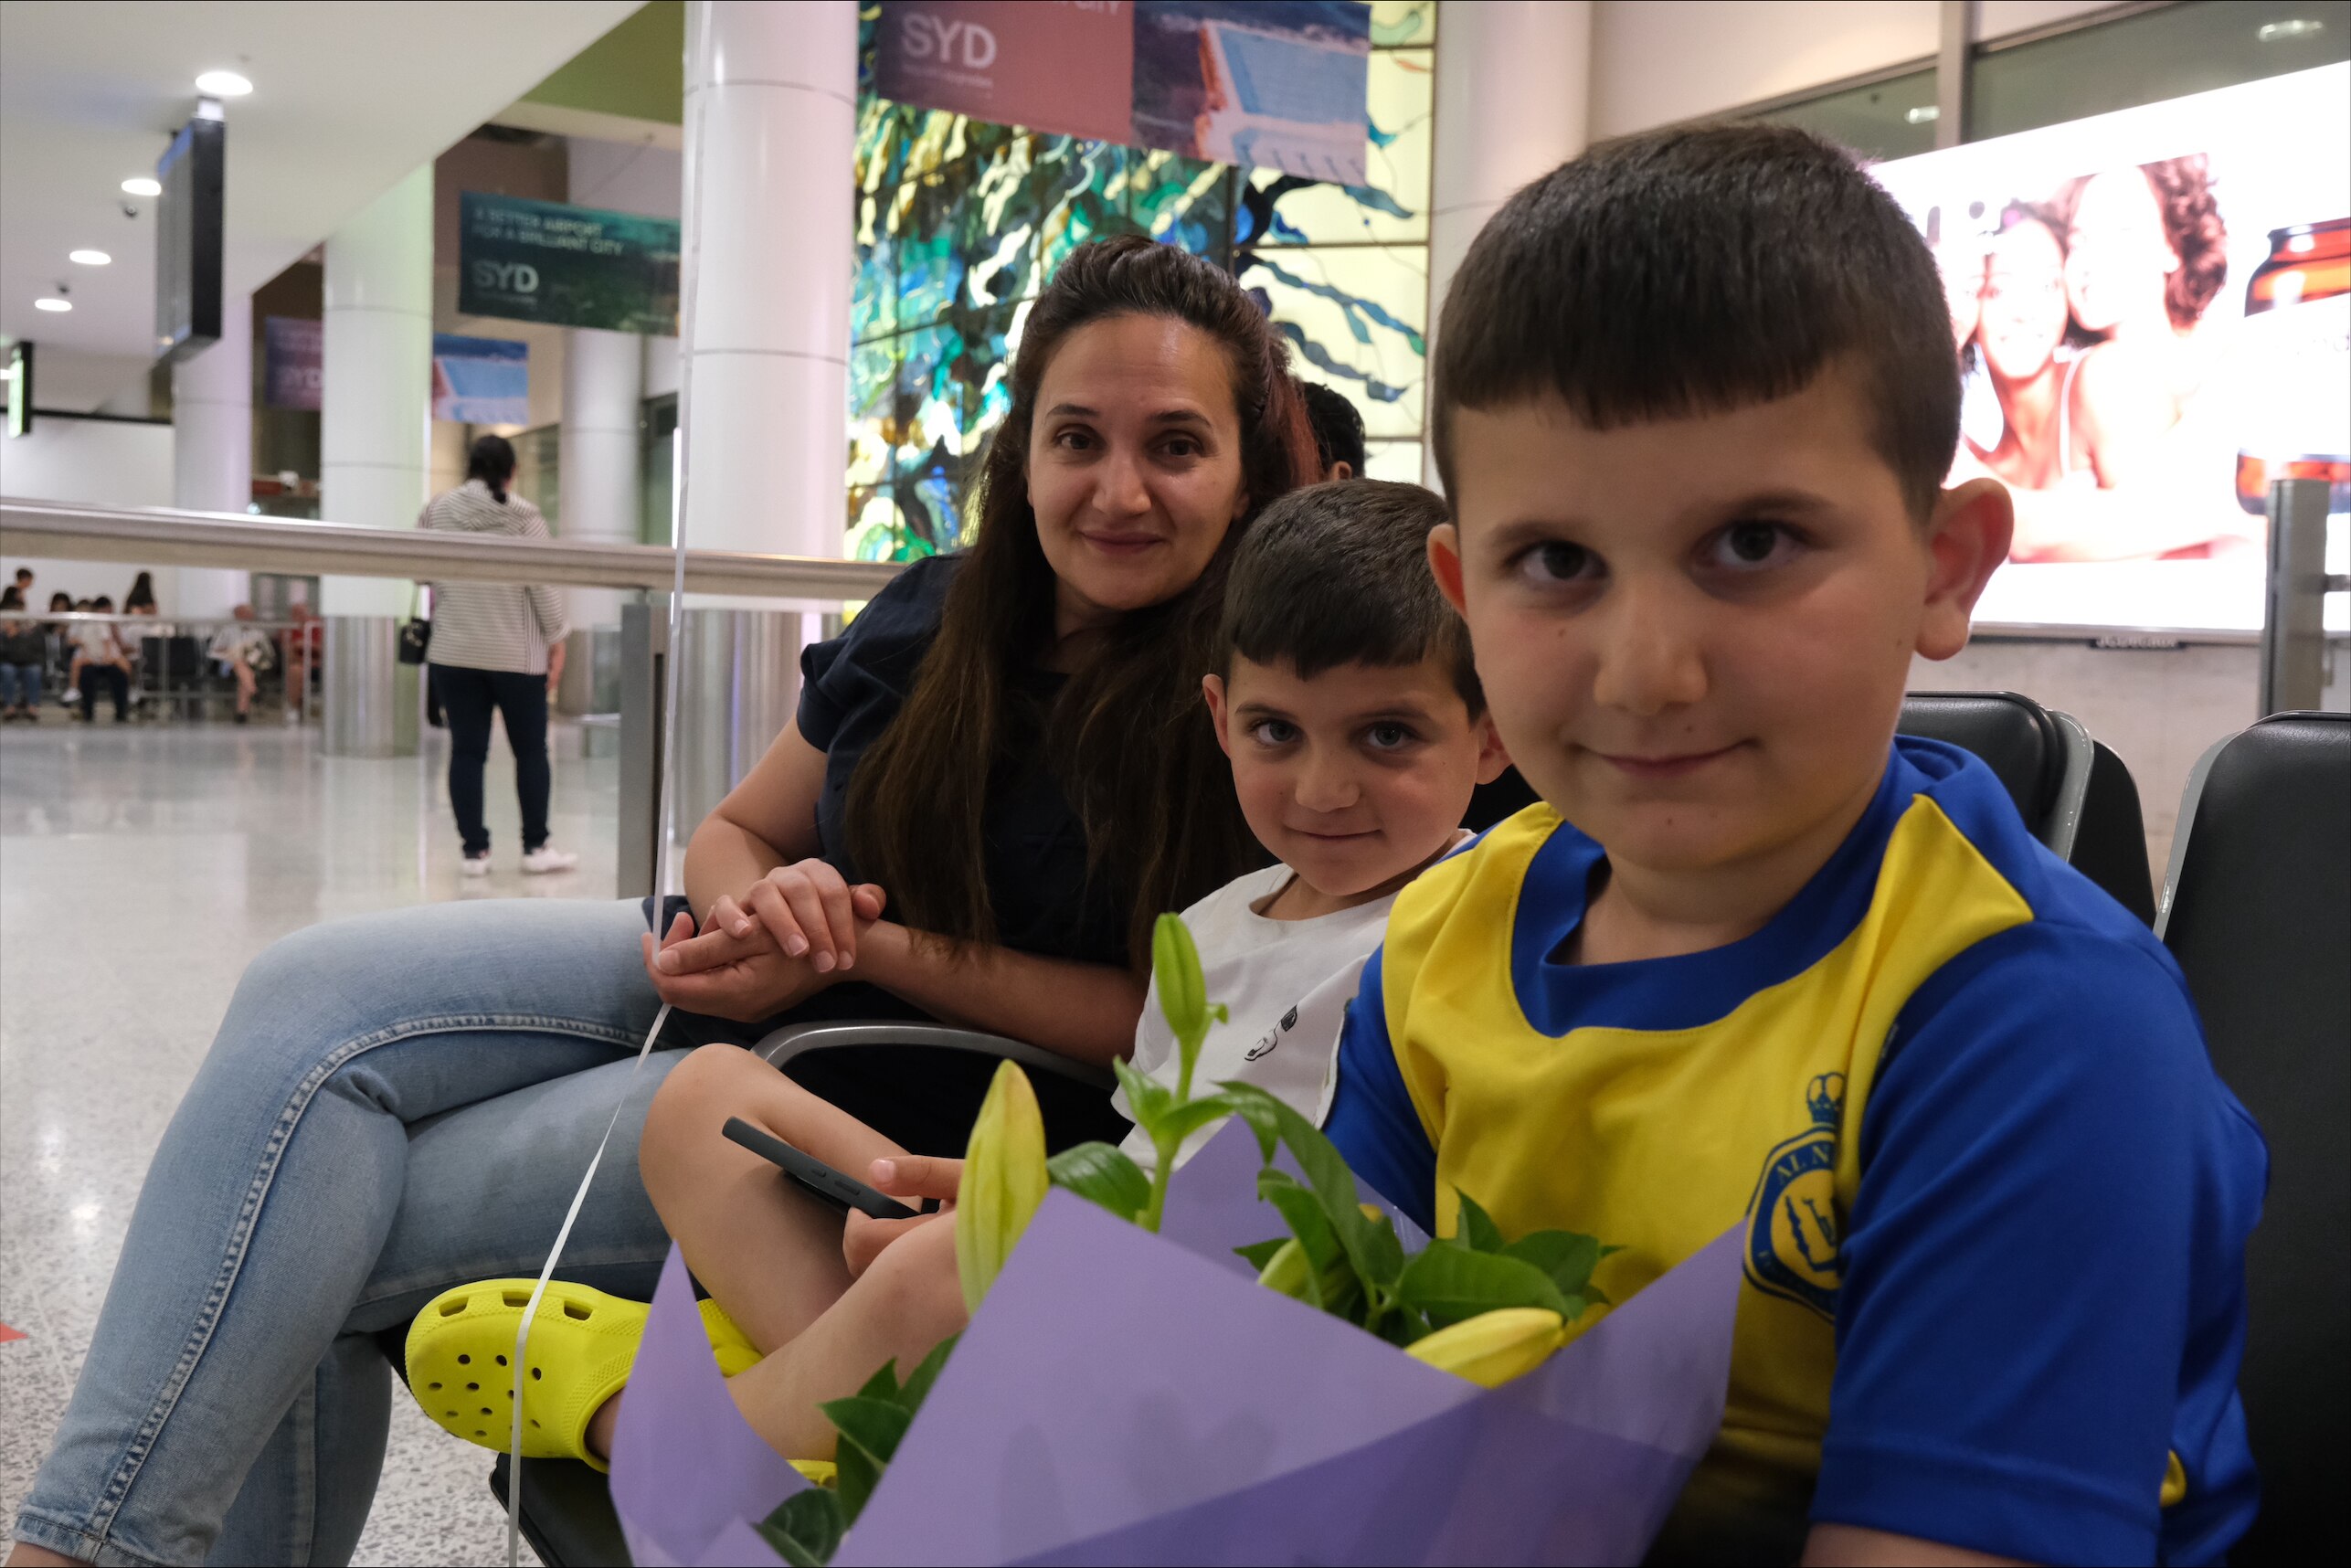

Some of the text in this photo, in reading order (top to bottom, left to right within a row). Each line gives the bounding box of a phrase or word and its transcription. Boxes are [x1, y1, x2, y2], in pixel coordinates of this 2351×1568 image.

[902, 13, 997, 69] SYD
[544, 217, 602, 238] AIRPORT
[588, 238, 625, 257] CITY
[472, 260, 540, 293] SYD
